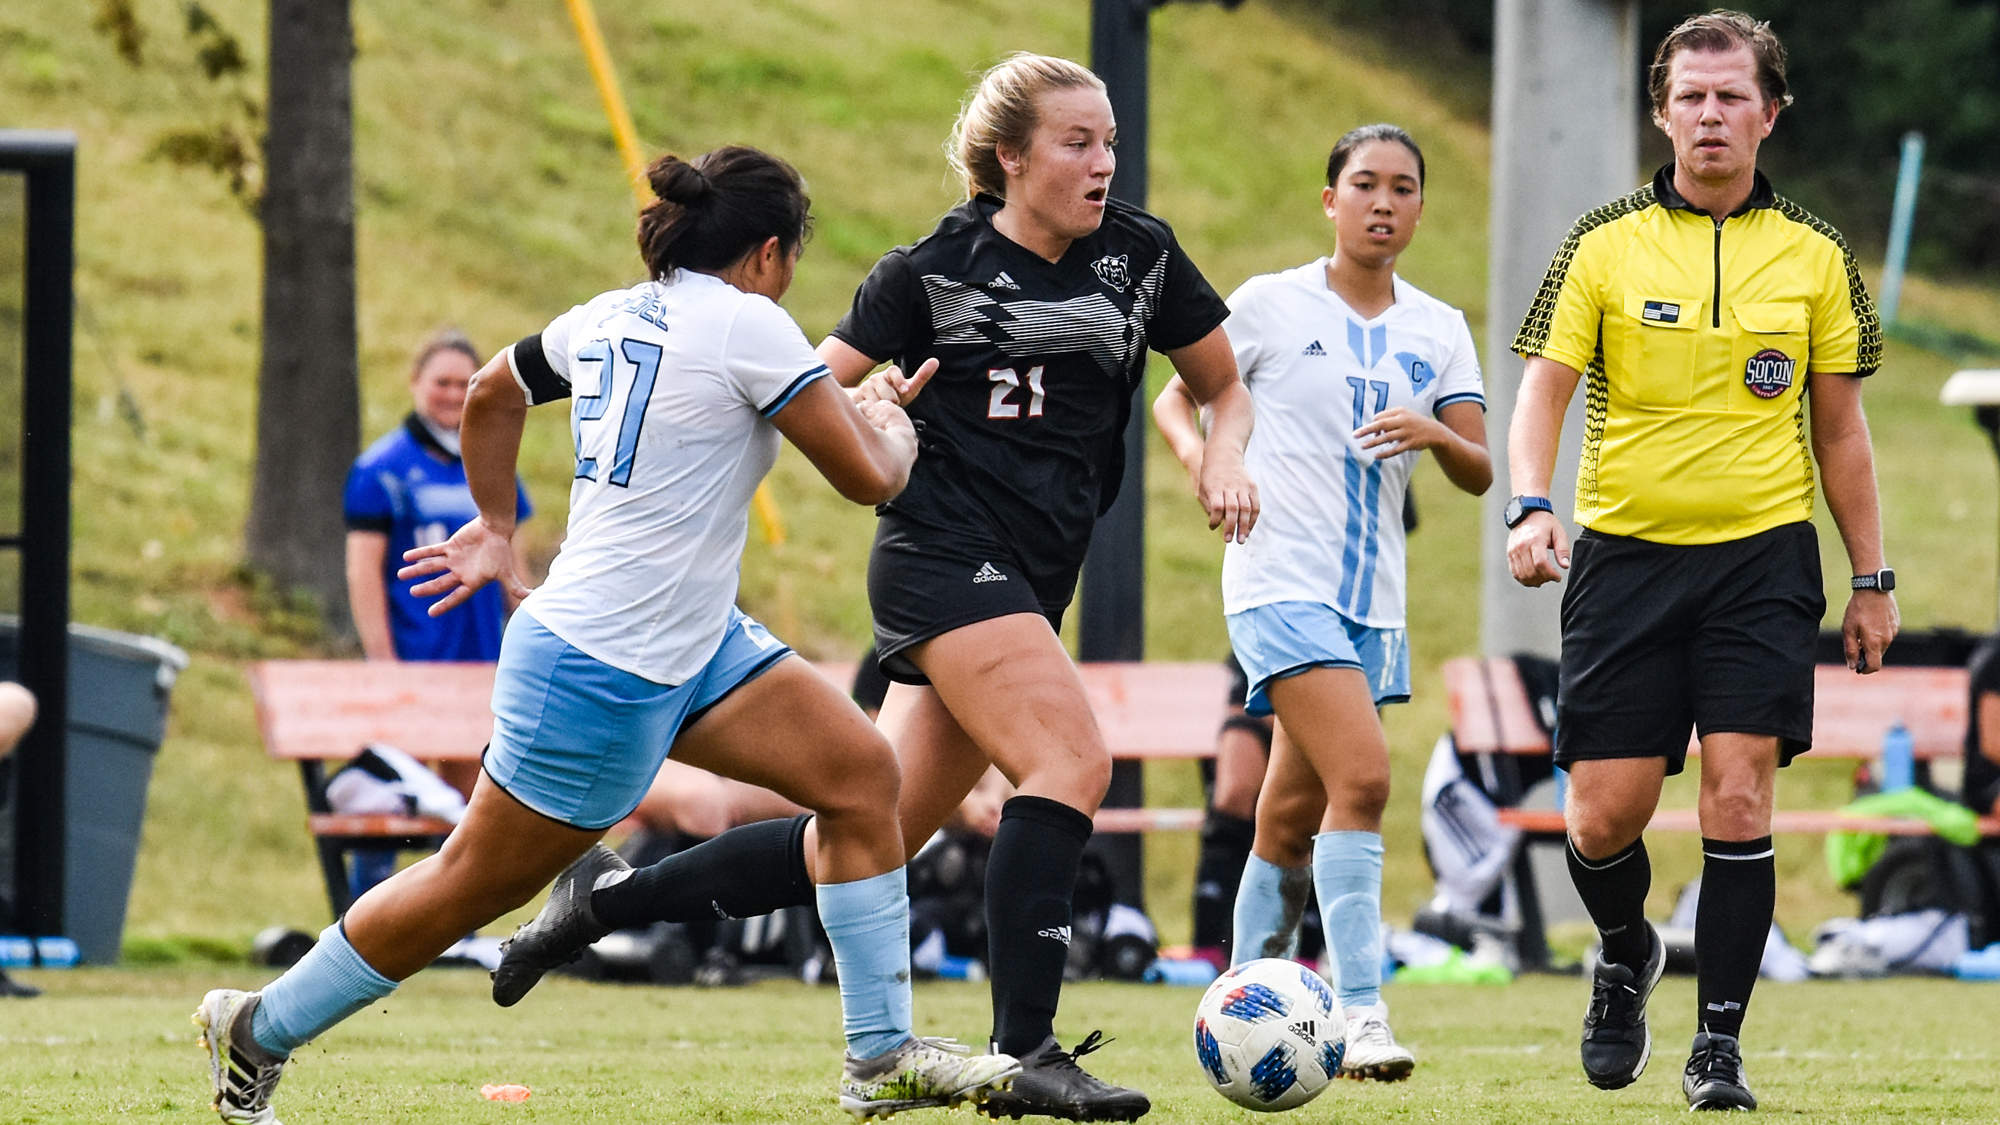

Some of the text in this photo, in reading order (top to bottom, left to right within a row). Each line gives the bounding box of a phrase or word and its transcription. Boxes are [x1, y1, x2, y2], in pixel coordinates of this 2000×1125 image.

[988, 281, 1021, 290] addas
[1411, 361, 1424, 383] C
[987, 364, 1045, 419] 21
[575, 337, 663, 488] 27
[1346, 376, 1389, 433] 11
[973, 574, 1008, 583] adidas
[1037, 929, 1070, 948] adid
[1288, 1024, 1317, 1047] adidas
